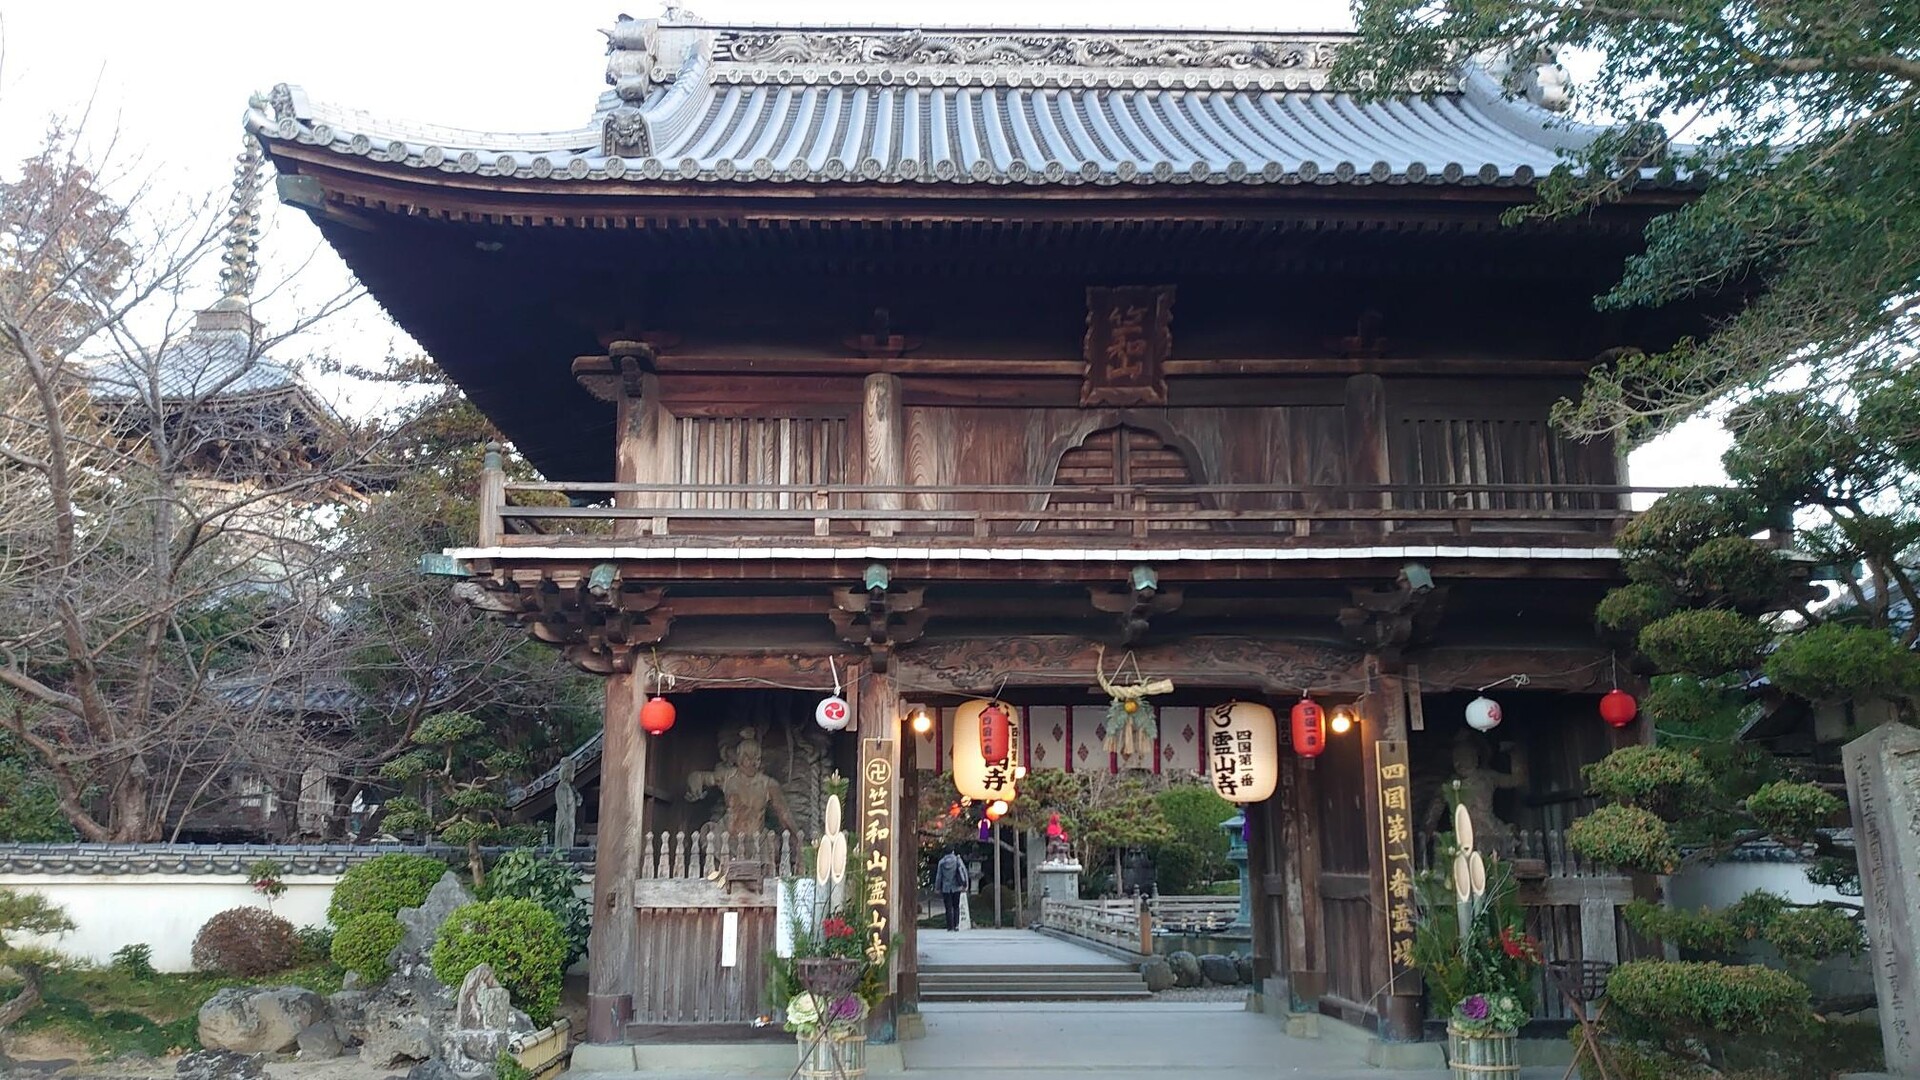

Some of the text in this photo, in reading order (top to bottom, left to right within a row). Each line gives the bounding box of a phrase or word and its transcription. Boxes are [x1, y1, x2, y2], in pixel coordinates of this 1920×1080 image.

[1236, 729, 1255, 786] 四国第一番
[1381, 762, 1416, 969] 四国第一番霊場
